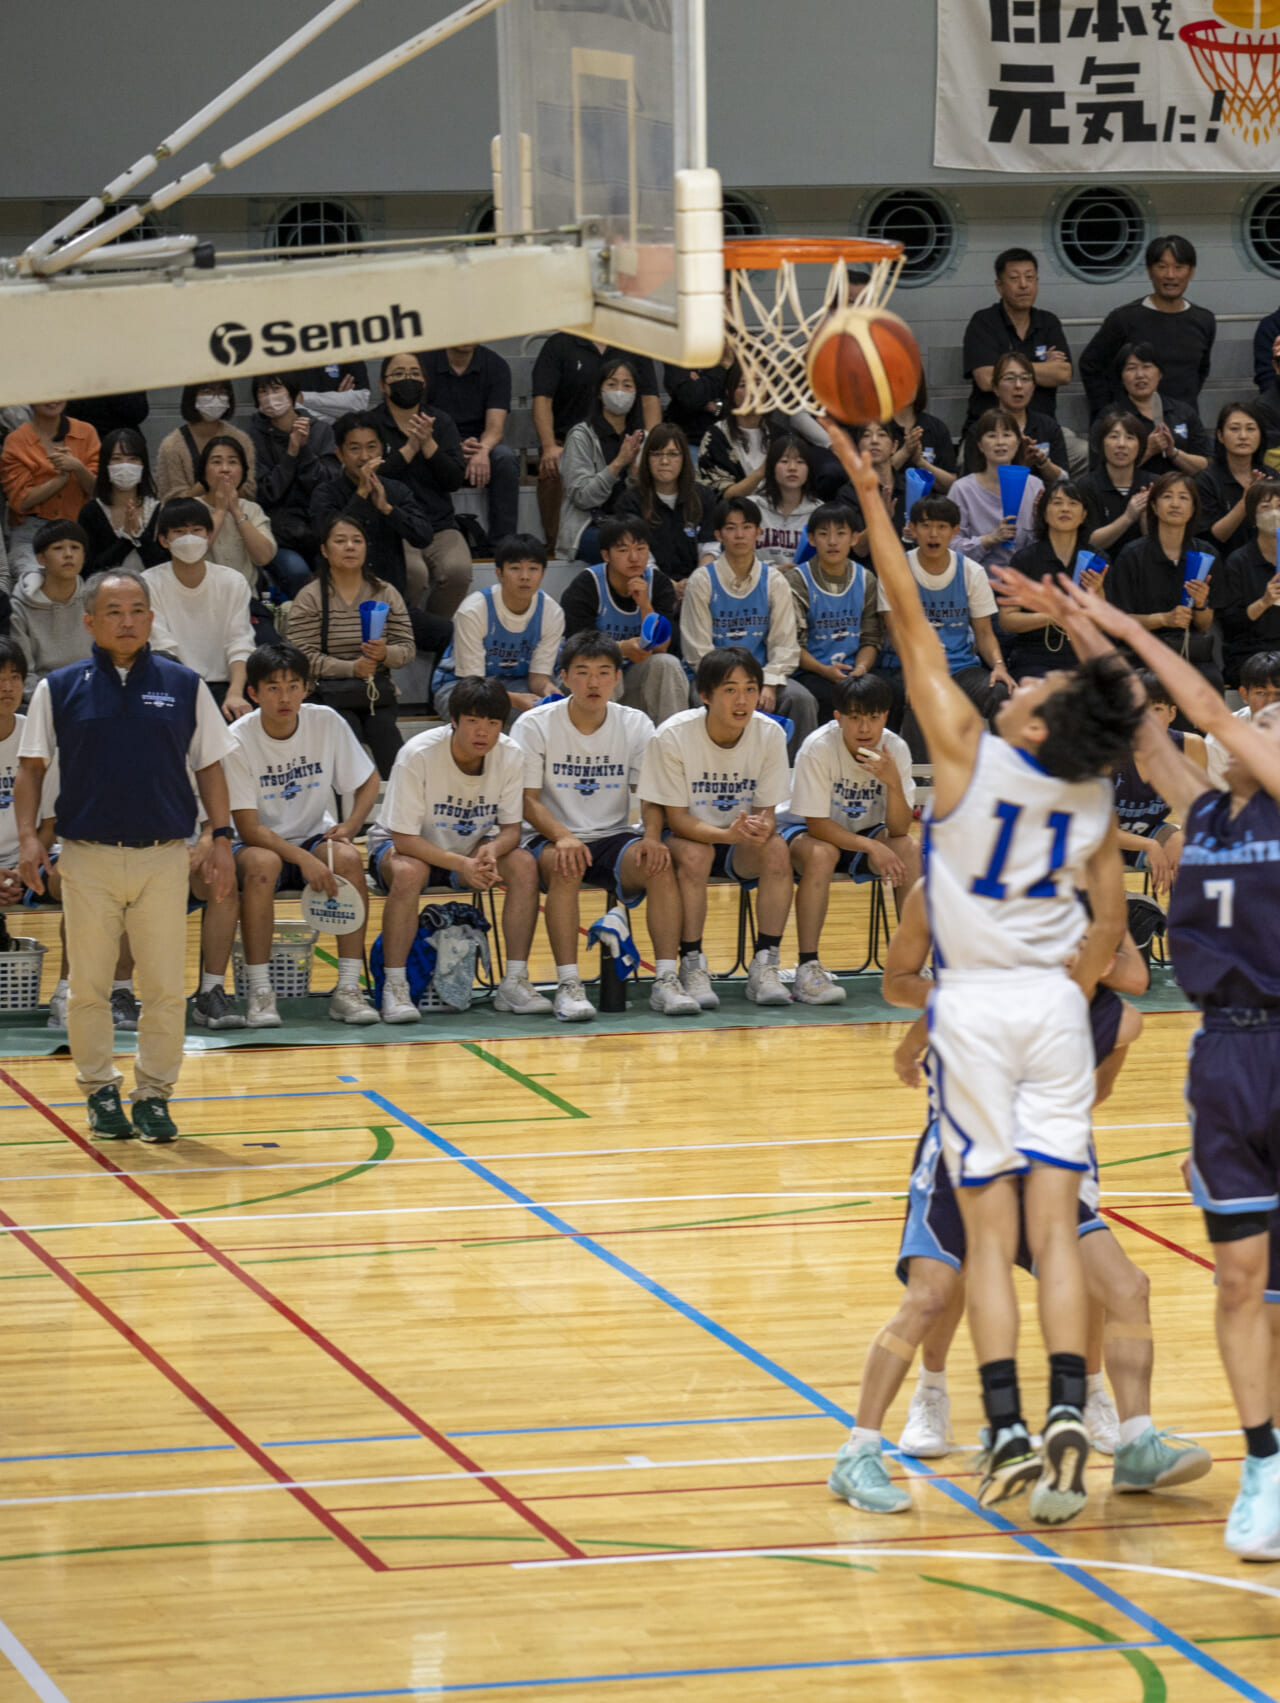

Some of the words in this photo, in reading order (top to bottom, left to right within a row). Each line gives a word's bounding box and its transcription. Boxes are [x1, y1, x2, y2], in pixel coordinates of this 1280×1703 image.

[260, 304, 423, 357] Senoh
[970, 798, 1074, 900] 11
[1203, 878, 1234, 928] 7
